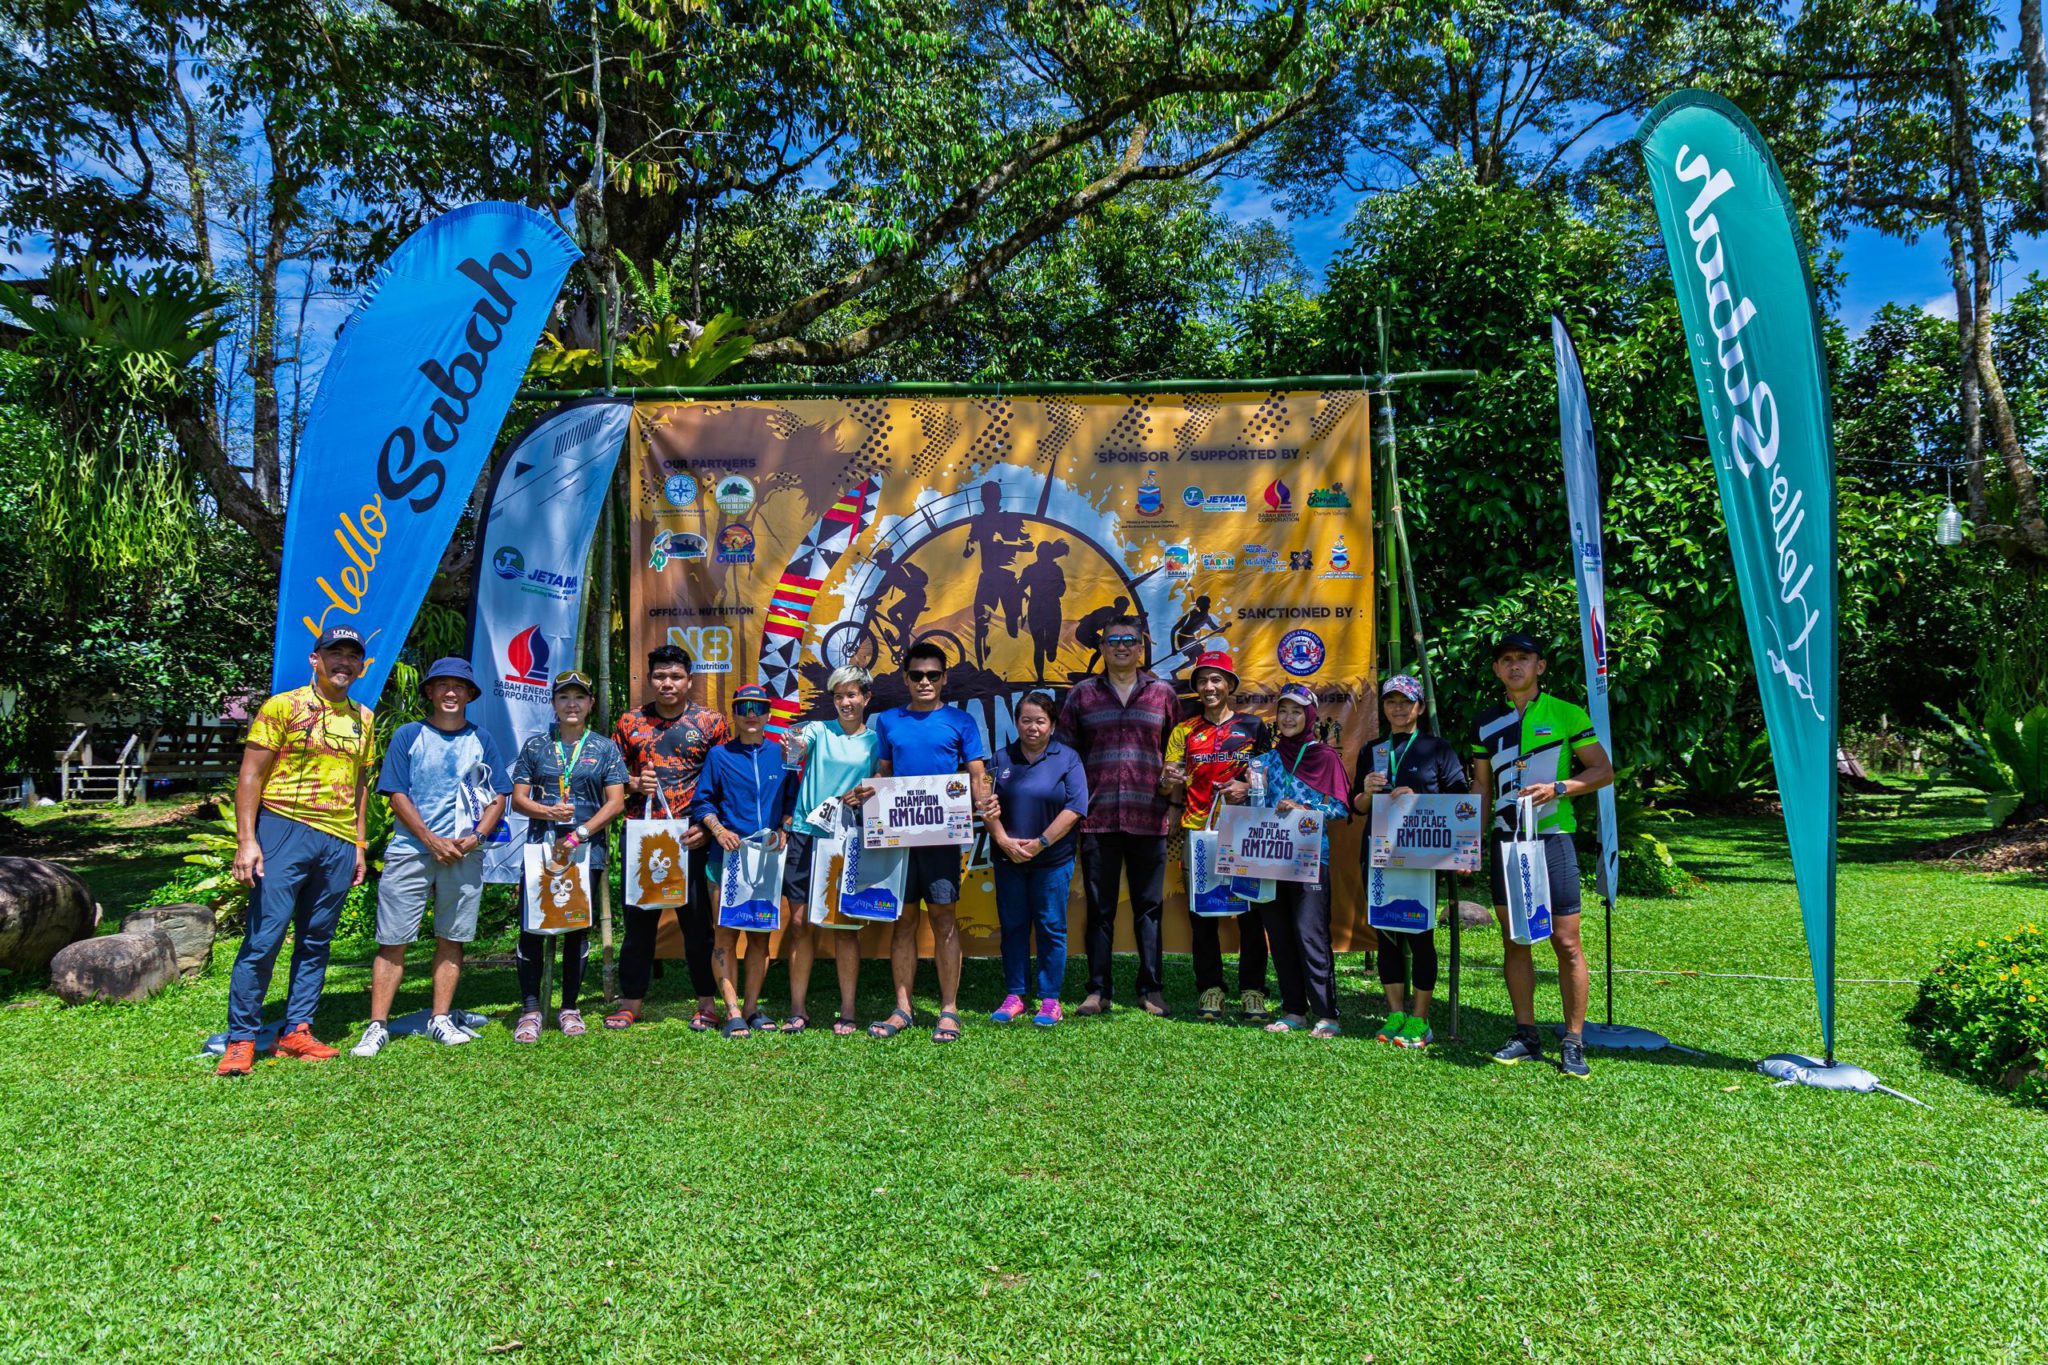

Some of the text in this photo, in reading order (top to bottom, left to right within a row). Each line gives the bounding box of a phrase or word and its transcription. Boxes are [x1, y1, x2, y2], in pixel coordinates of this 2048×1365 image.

[376, 246, 533, 514] Sabah
[1098, 451, 1169, 463] SPONSOR
[1191, 450, 1277, 462] SUPPORTED
[1282, 449, 1299, 460] BY
[663, 458, 756, 469] OUR PARTNERS
[1206, 495, 1246, 503] JETAMA
[302, 493, 388, 638] Hello
[1203, 558, 1235, 566] SABAH
[528, 569, 578, 588] JETAM
[649, 606, 754, 617] OFFICIAL NUTRITION
[1237, 607, 1331, 619] SANCTIONED
[1336, 607, 1353, 618] BY
[494, 680, 550, 697] SABAH ENERG
[1236, 694, 1275, 704] EVENT
[1192, 752, 1217, 762] TEAM
[895, 795, 939, 808] CHAMPION
[889, 806, 944, 828] RM1600
[1403, 816, 1447, 828] 3RD PLACE
[1248, 827, 1291, 840] 2ND PLACE
[1397, 828, 1452, 848] RM1000
[1241, 839, 1294, 860] RM1200
